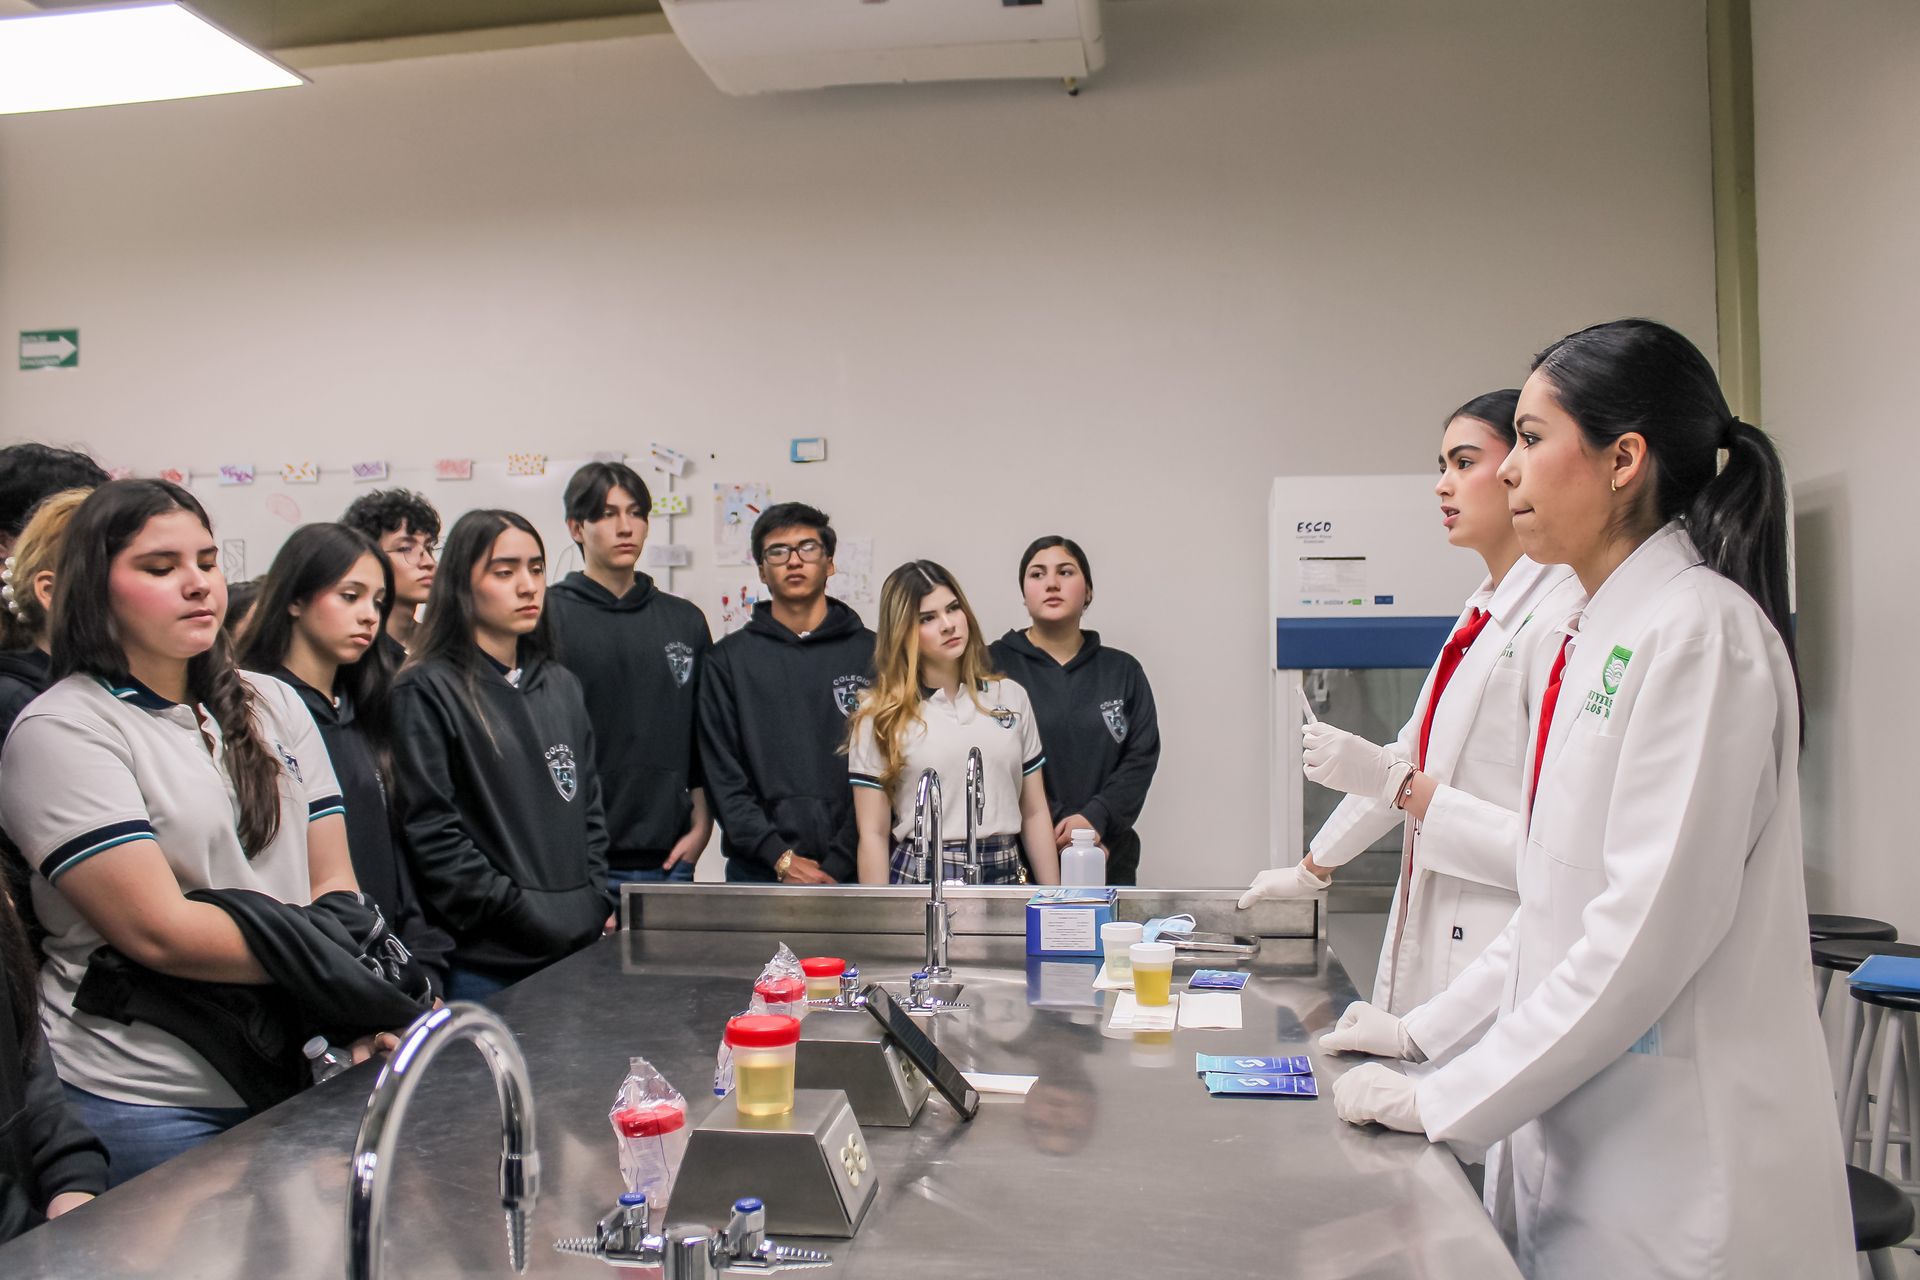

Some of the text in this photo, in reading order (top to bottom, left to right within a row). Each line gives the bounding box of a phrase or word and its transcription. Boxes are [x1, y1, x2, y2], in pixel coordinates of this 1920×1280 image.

[1297, 521, 1332, 533] ESCO
[833, 675, 871, 686] COLEGIO
[1585, 701, 1602, 715] LOS
[1454, 928, 1461, 938] A
